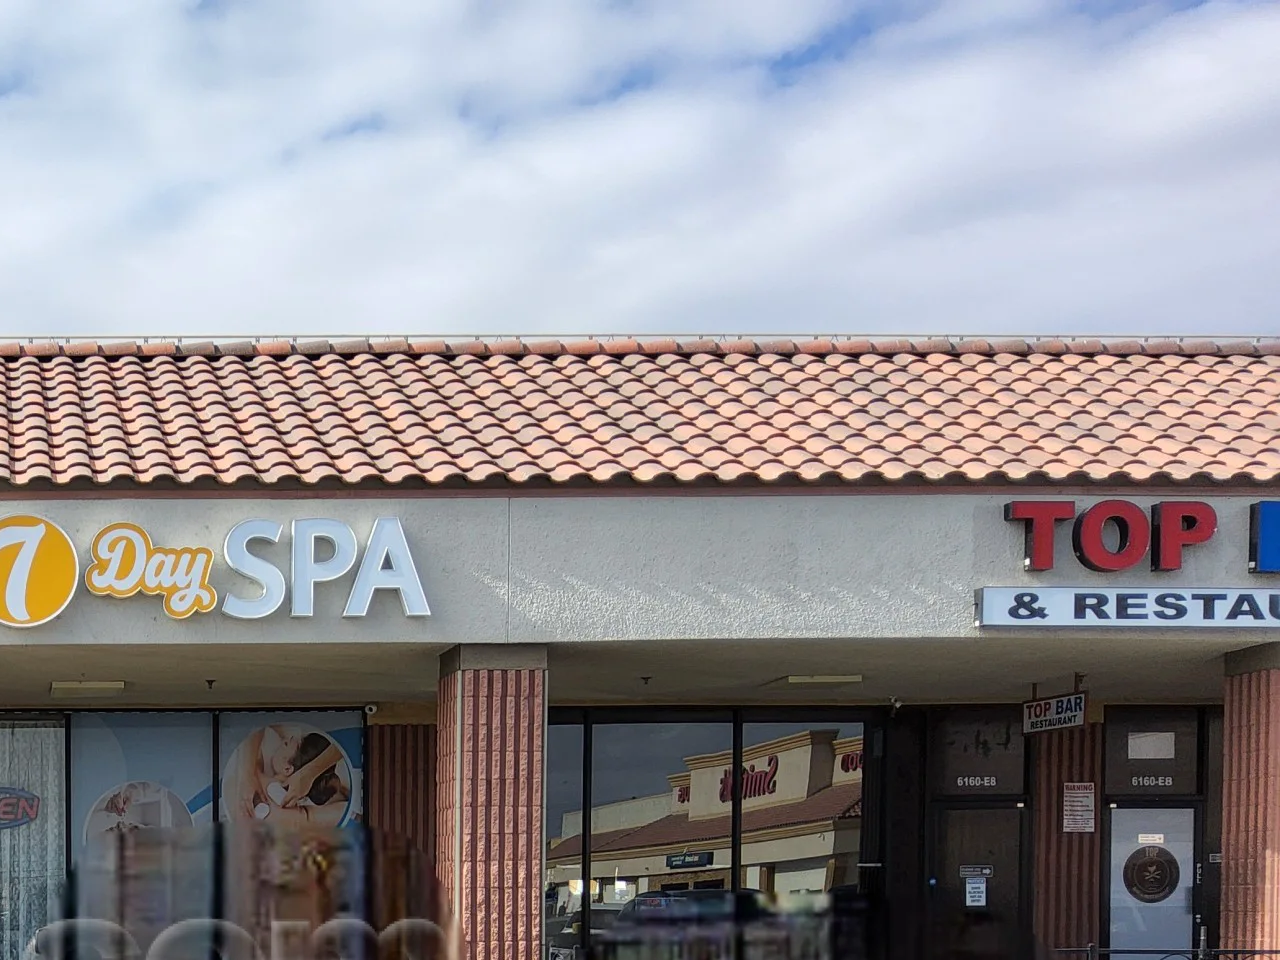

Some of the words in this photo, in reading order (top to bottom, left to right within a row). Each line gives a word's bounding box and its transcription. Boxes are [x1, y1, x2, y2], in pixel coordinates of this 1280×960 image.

[1005, 499, 1218, 571] TOP
[89, 525, 213, 615] Day
[221, 516, 432, 618] SPA
[1007, 592, 1050, 620] &
[1025, 701, 1052, 720] TOP
[1055, 695, 1083, 715] BAR
[1030, 714, 1078, 730] RESTAURANT
[956, 776, 997, 787] 6160-E8
